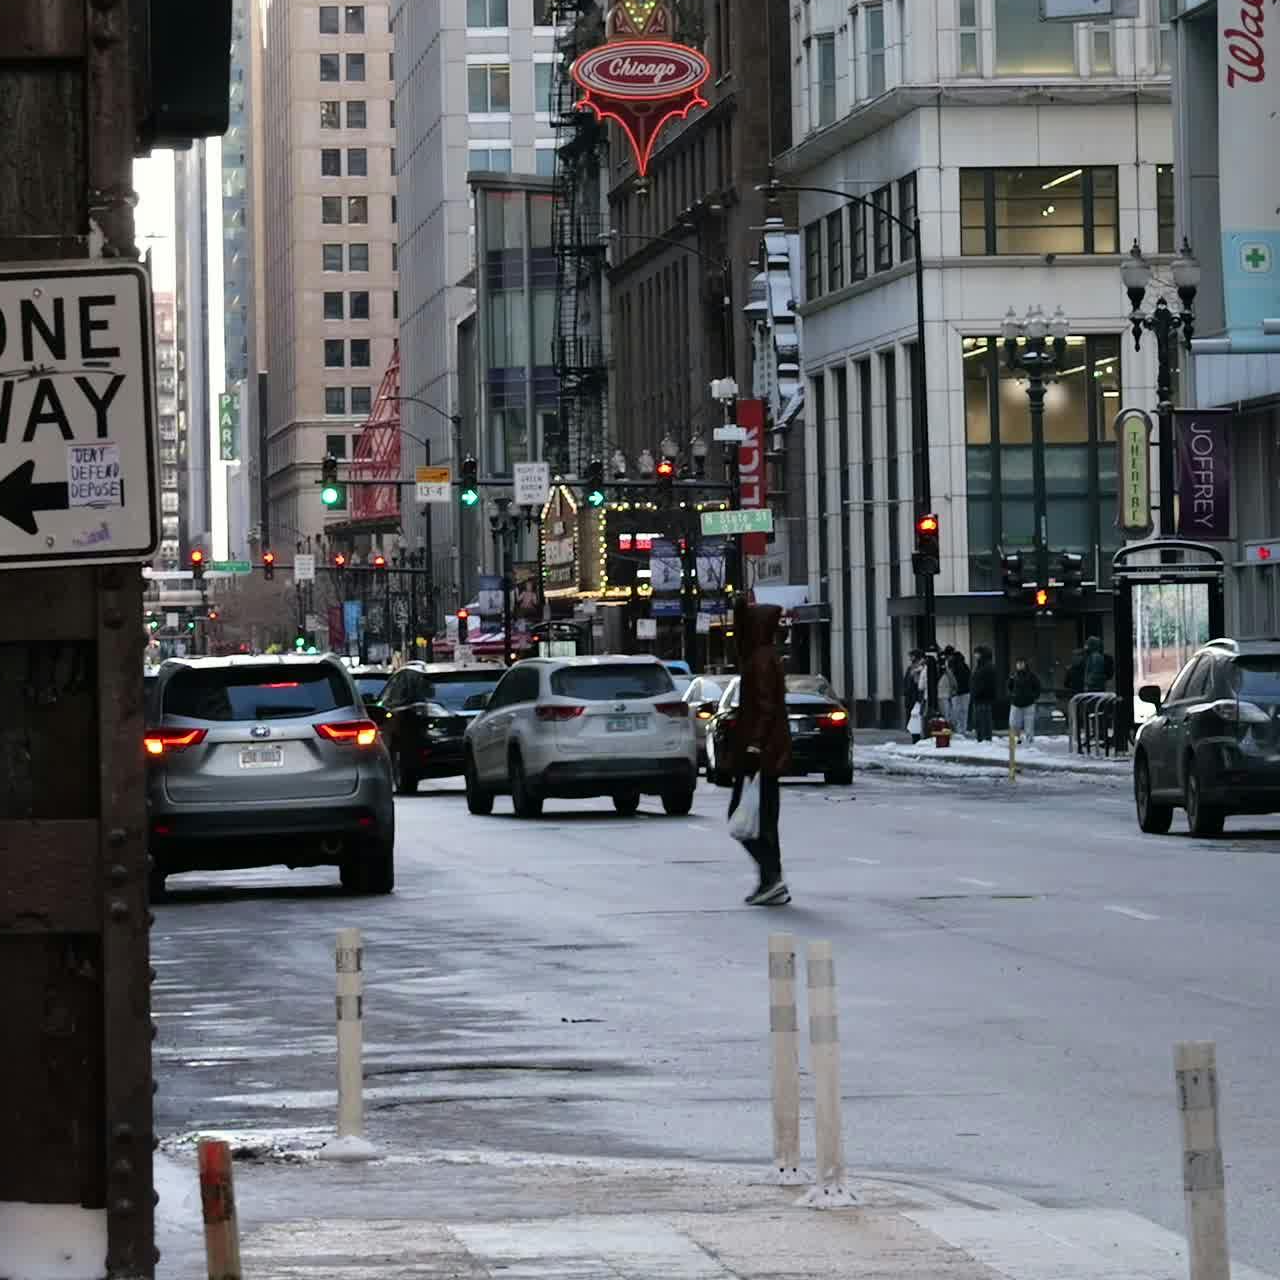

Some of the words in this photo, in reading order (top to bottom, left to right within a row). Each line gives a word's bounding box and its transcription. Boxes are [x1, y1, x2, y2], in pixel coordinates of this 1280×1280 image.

[608, 57, 677, 84] Chicago
[221, 394, 233, 460] PARK
[72, 447, 106, 464] DENY
[739, 425, 760, 511] LICK
[71, 462, 120, 481] DEFEND
[1190, 421, 1215, 529] JOFFREY
[71, 480, 121, 499] DEPOSE
